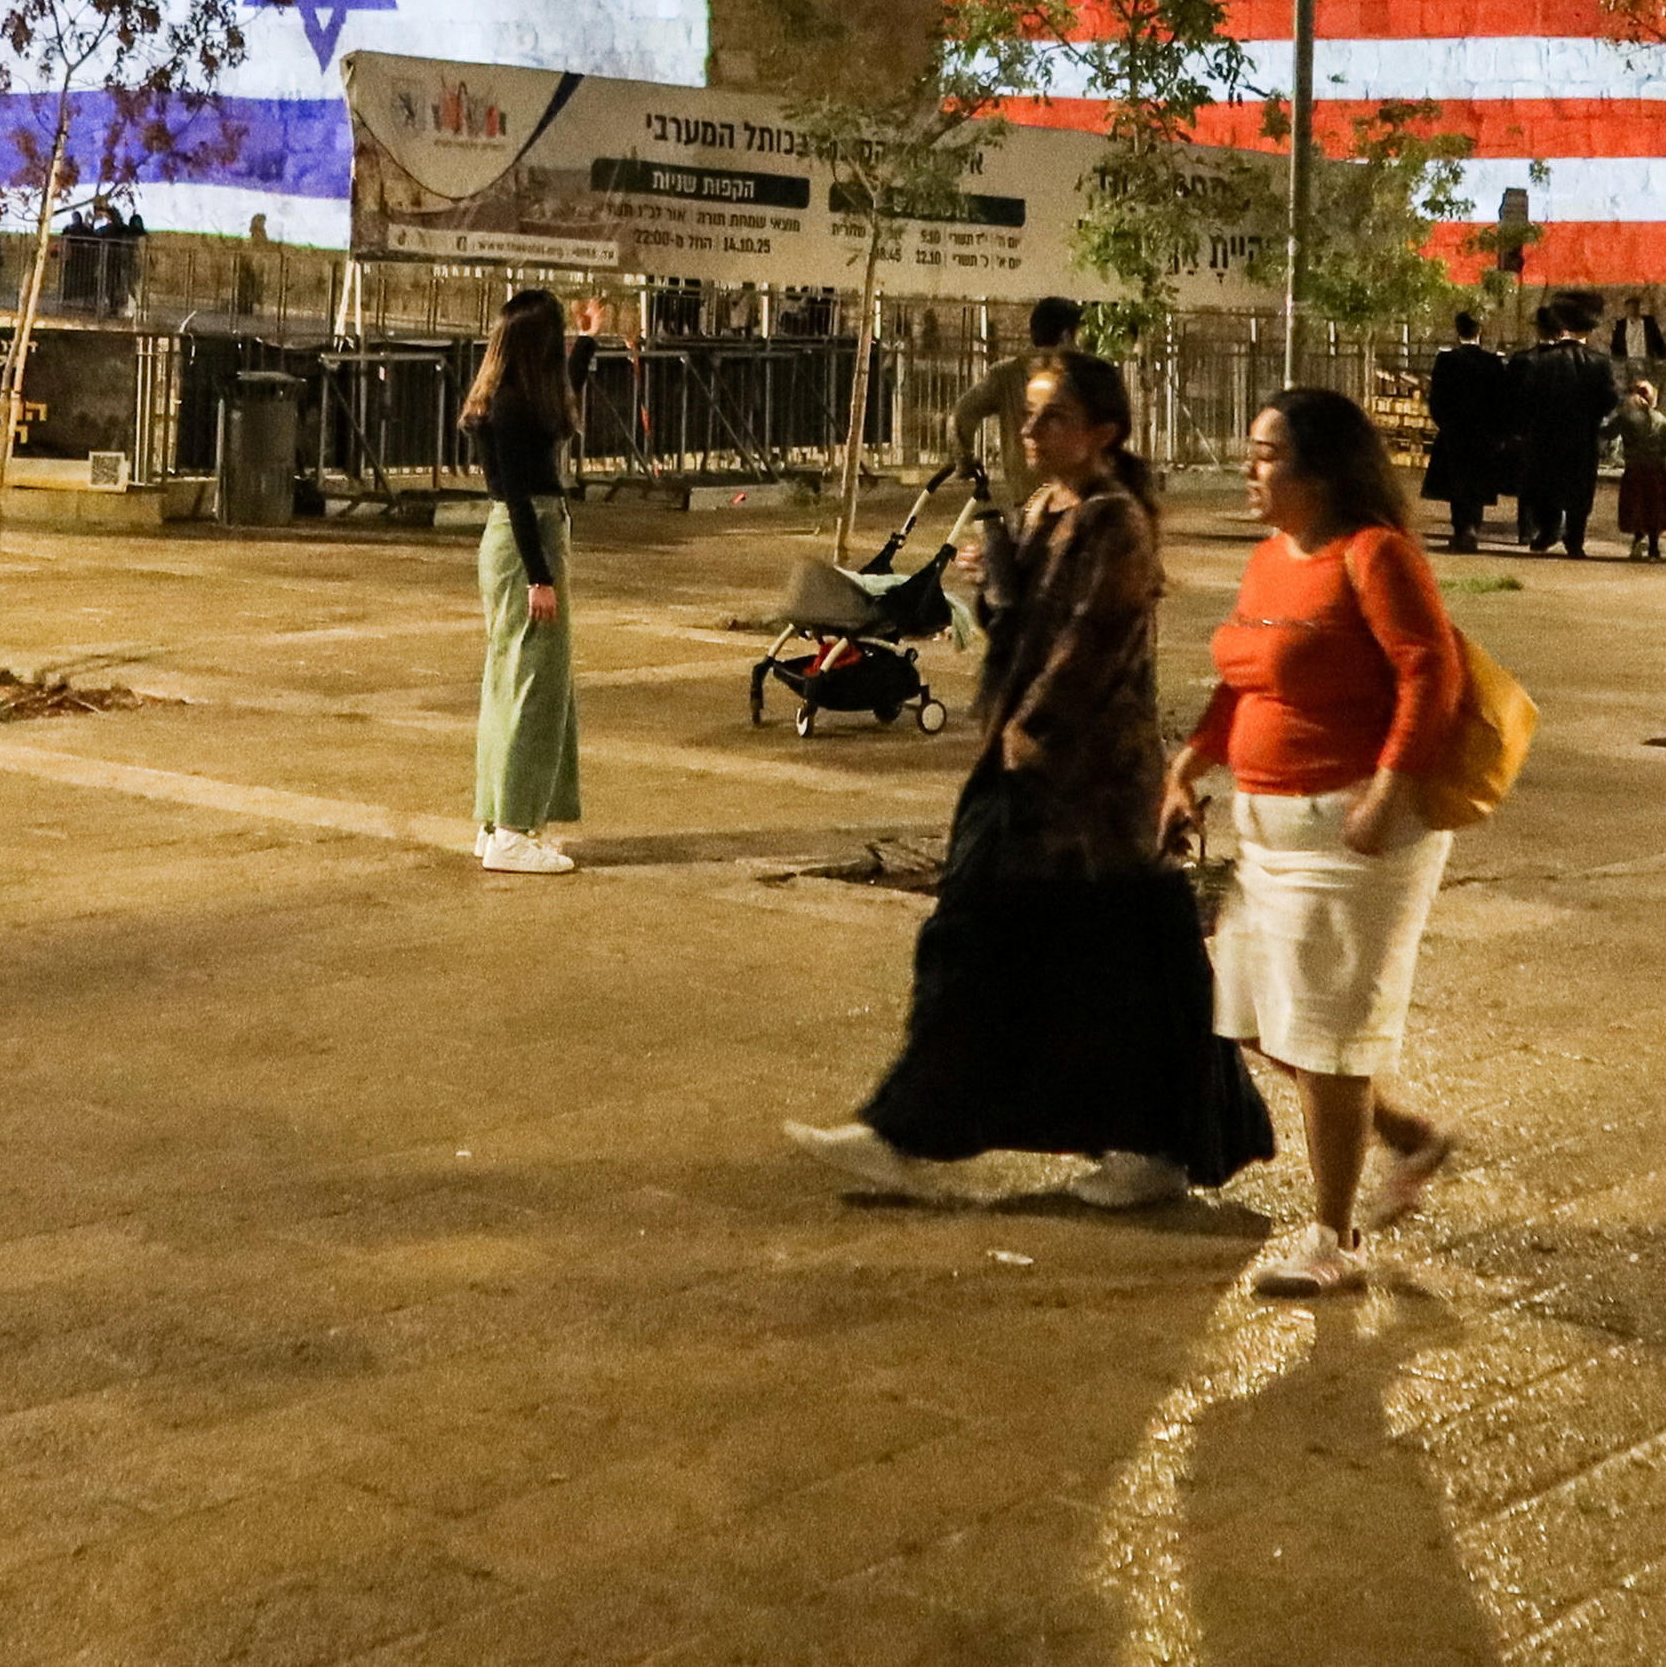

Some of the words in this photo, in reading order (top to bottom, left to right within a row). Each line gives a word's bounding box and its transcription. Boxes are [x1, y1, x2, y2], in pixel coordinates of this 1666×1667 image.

[646, 112, 735, 150] המערבי
[652, 171, 697, 194] שניות
[702, 178, 755, 201] הקפות
[667, 207, 686, 223] אור
[696, 210, 726, 227] תורה
[730, 213, 767, 230] שמחת
[689, 235, 713, 251] החל
[723, 236, 771, 254] 14.10.25
[915, 249, 942, 265] 12.10
